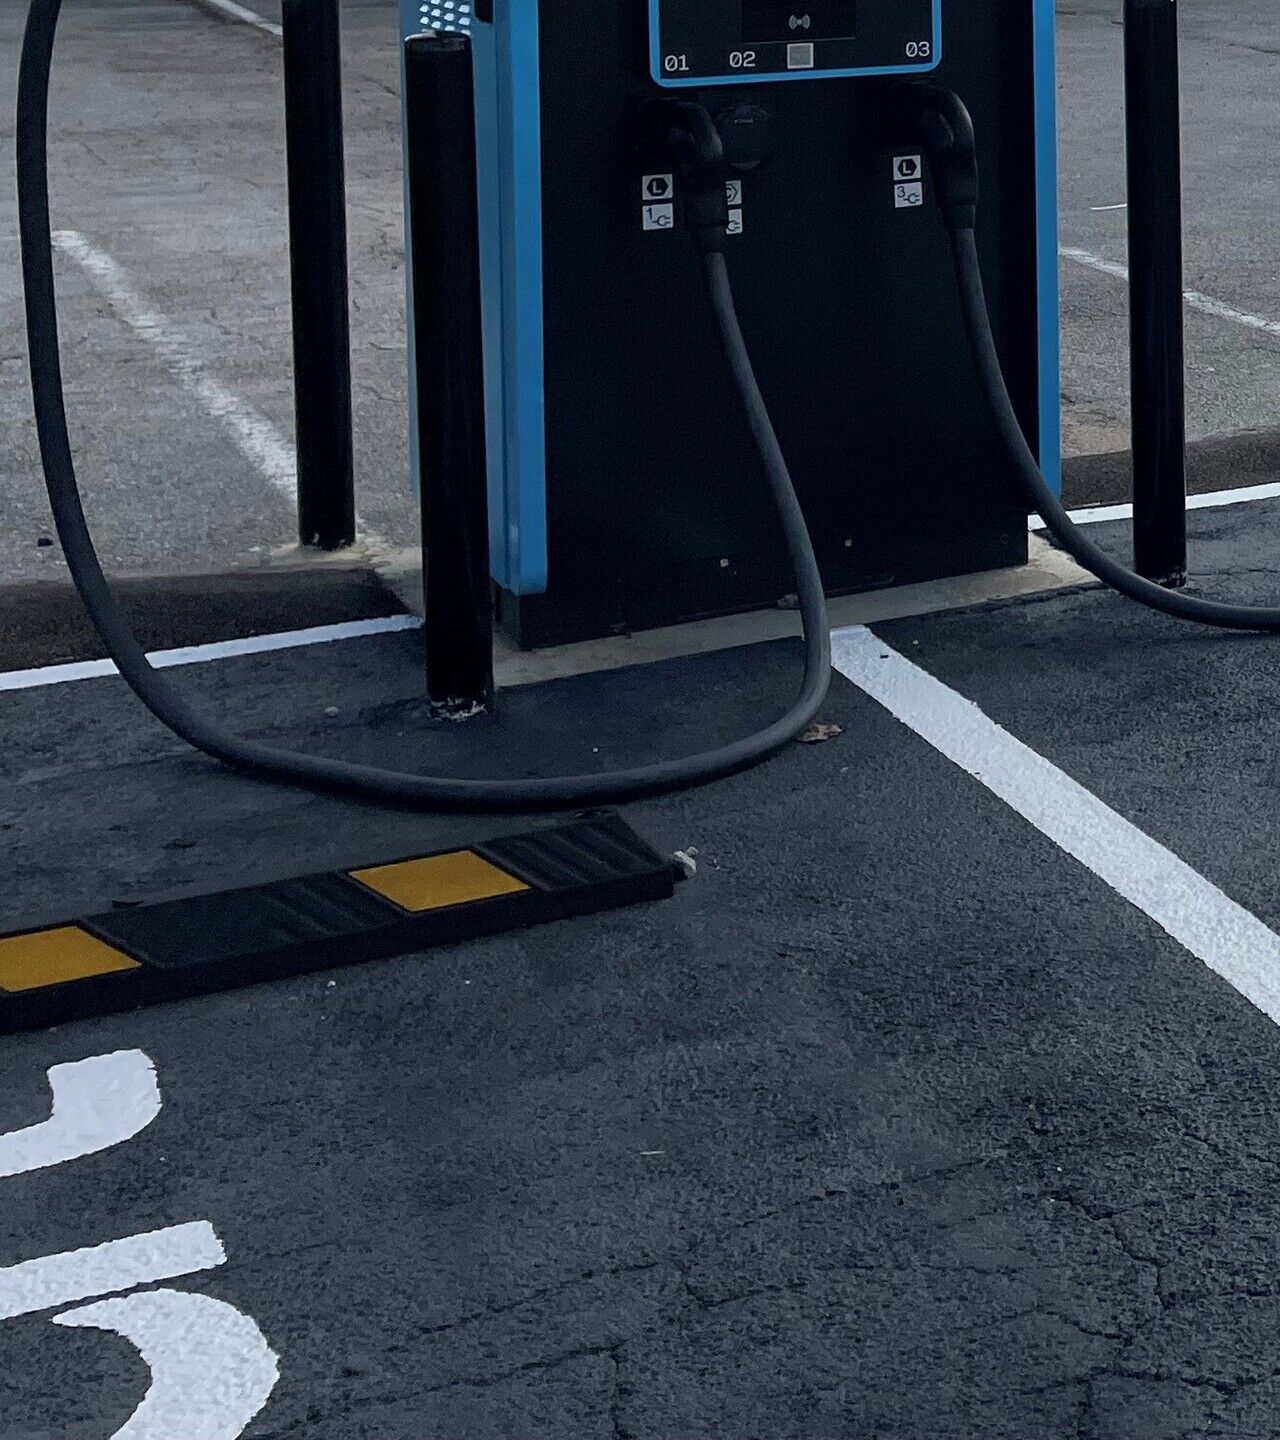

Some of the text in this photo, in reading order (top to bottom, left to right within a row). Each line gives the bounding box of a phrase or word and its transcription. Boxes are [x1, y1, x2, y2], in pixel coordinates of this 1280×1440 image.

[905, 41, 930, 57] 03
[664, 55, 689, 72] 01
[729, 51, 756, 68] 02
[902, 162, 911, 174] L
[652, 180, 661, 194] L
[896, 186, 906, 199] 3
